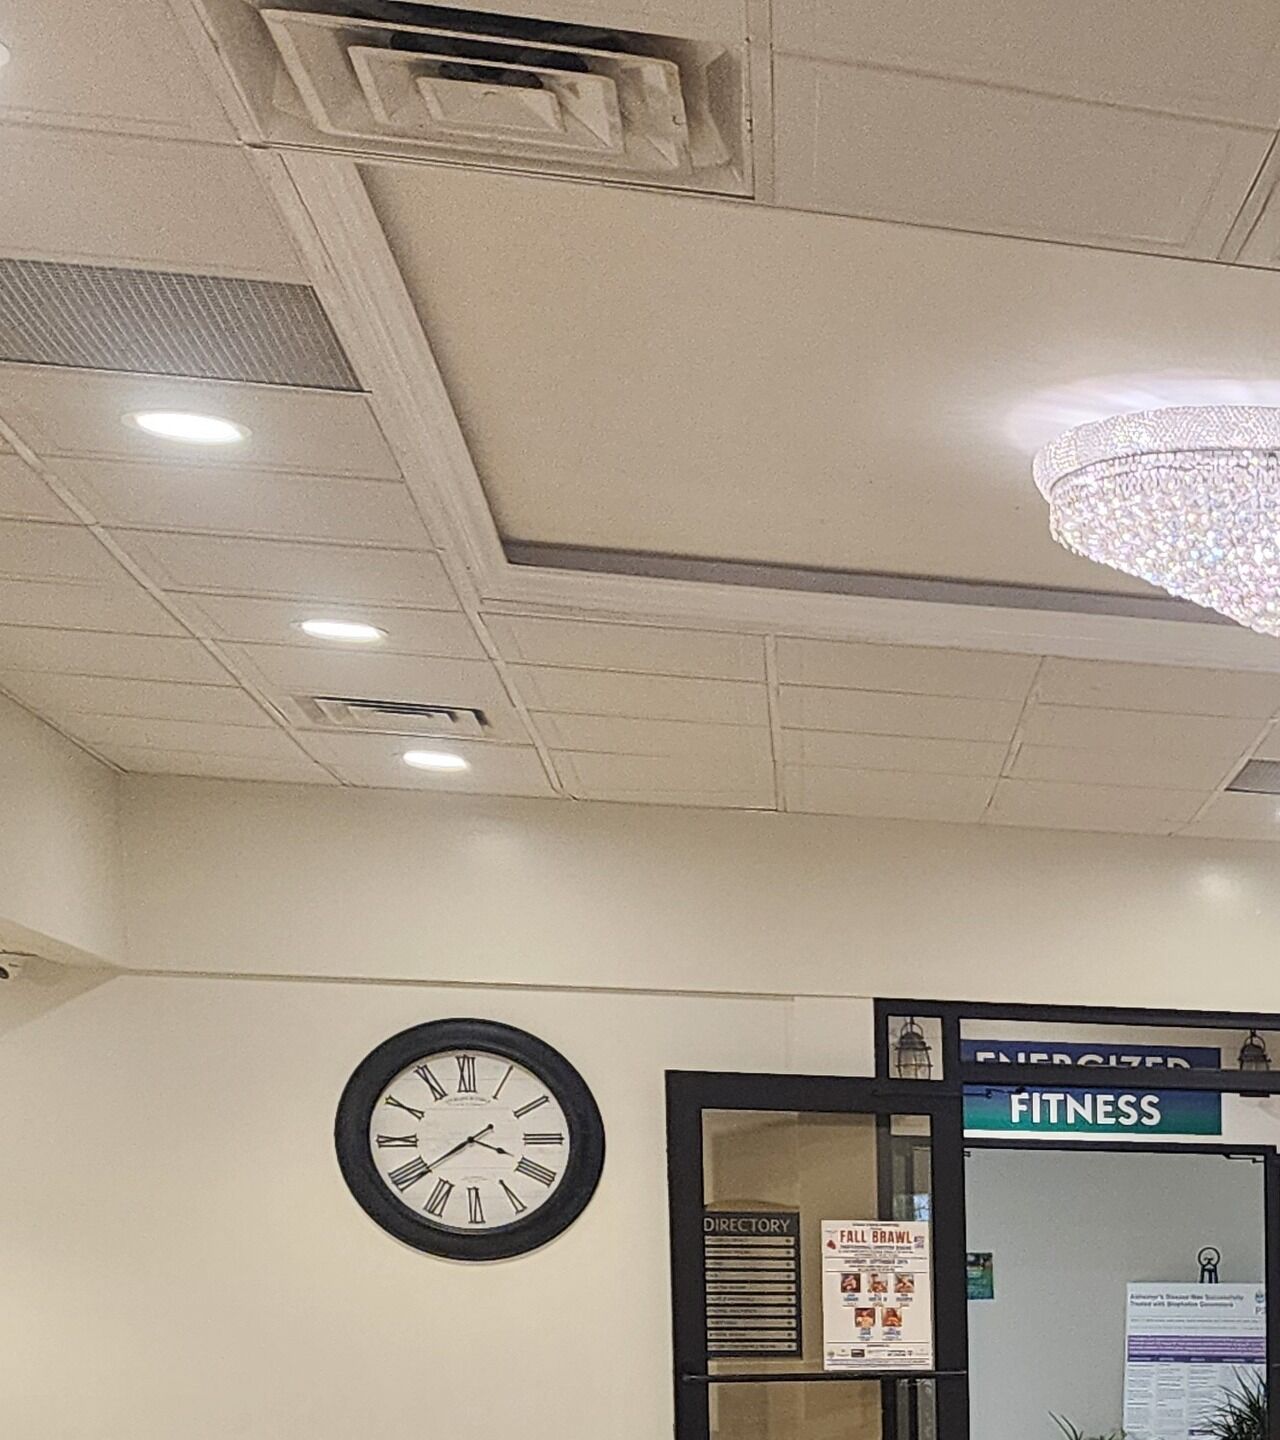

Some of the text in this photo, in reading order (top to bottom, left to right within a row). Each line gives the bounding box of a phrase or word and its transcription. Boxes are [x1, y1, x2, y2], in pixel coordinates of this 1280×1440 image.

[1010, 1091, 1162, 1126] FITNESS
[703, 1217, 791, 1233] DIRECTORY
[839, 1229, 867, 1244] FALL
[871, 1230, 913, 1244] BRAWL
